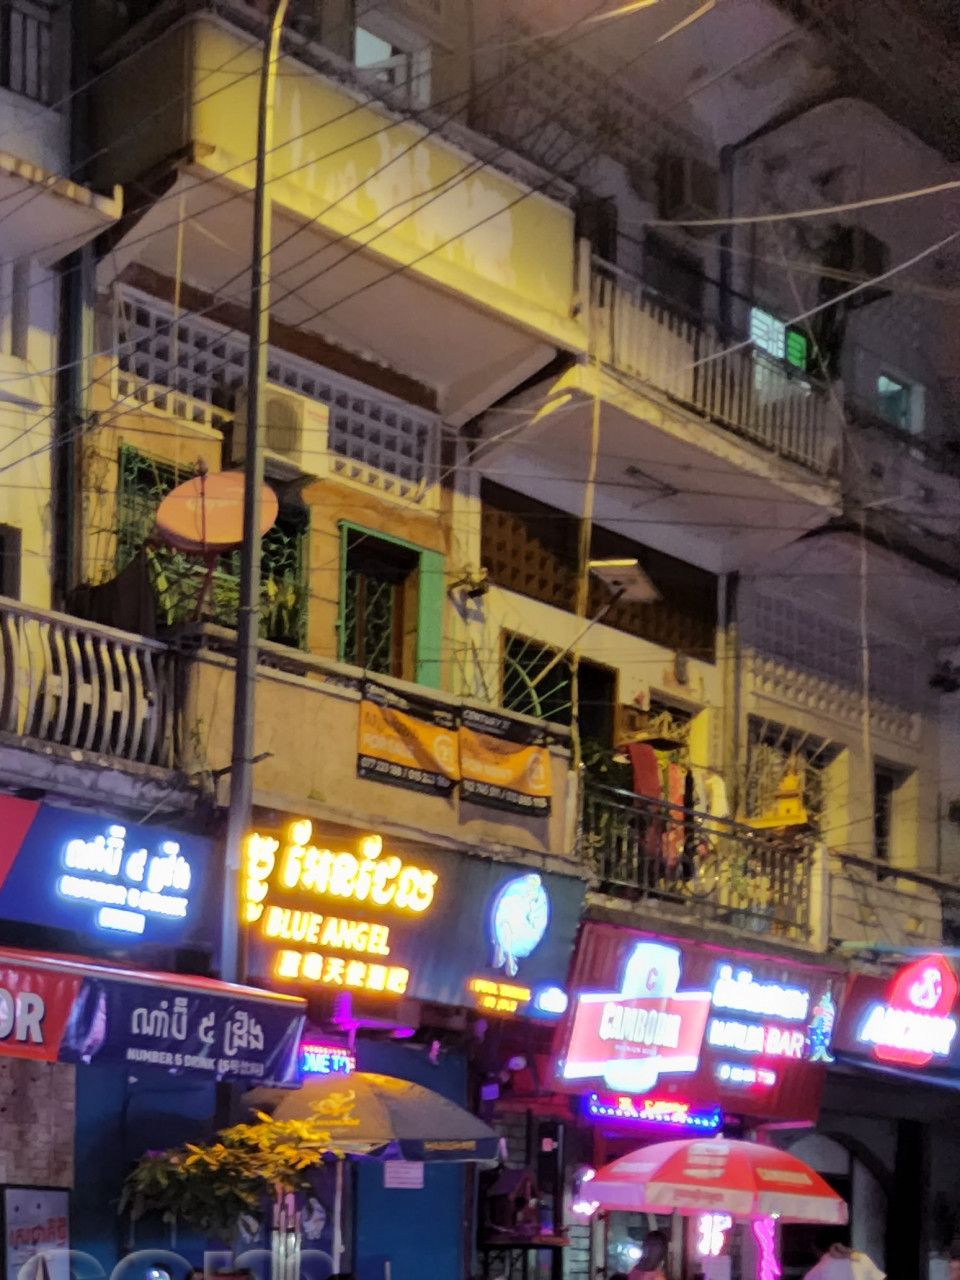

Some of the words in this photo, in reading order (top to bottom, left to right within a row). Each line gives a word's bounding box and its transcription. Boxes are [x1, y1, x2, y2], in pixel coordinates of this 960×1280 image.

[264, 905, 324, 944] BLUE
[320, 916, 390, 956] ANGEL
[126, 1047, 174, 1066] NUMBER
[765, 1029, 805, 1058] BAR
